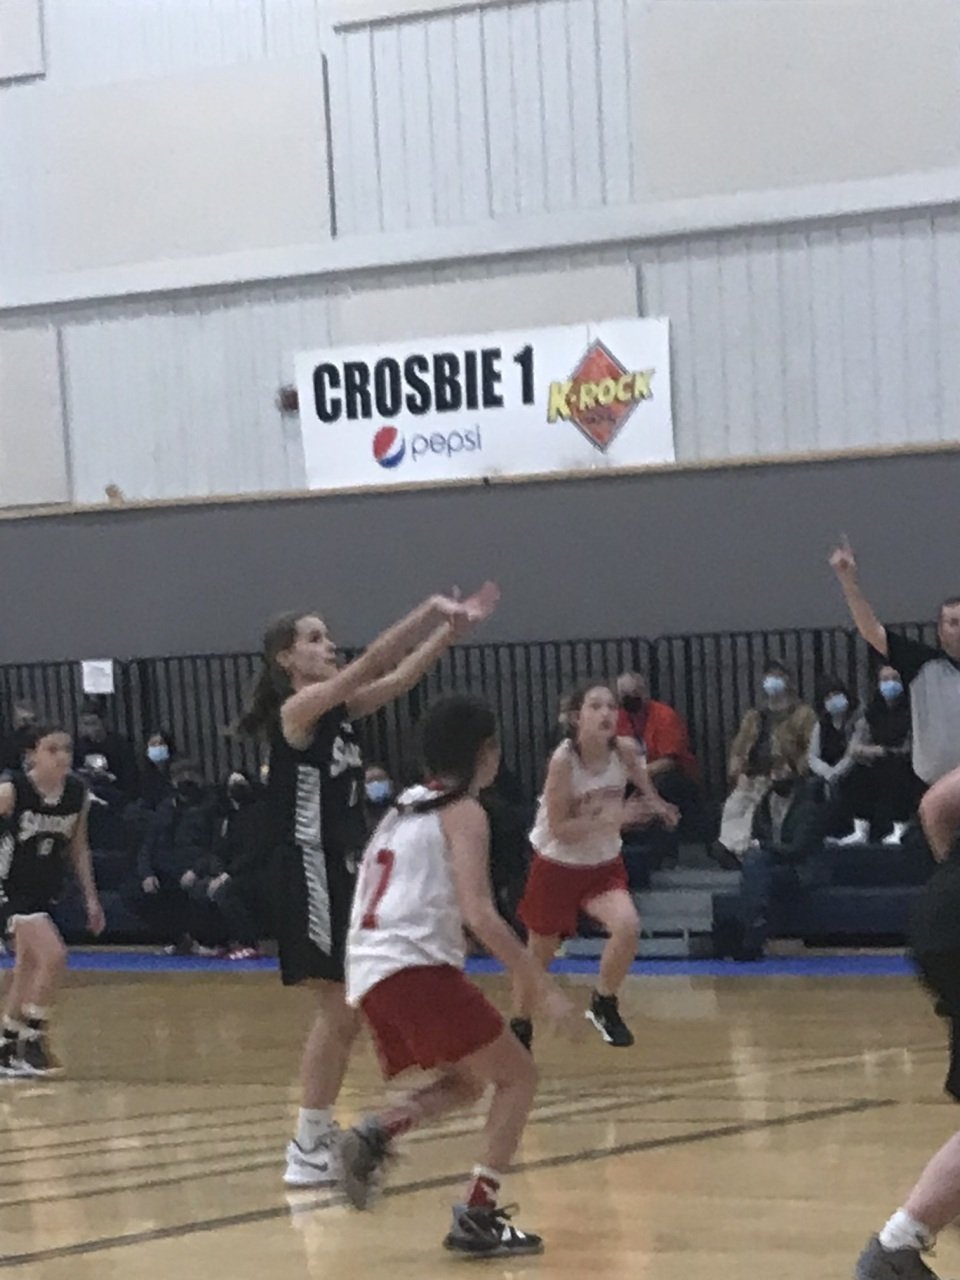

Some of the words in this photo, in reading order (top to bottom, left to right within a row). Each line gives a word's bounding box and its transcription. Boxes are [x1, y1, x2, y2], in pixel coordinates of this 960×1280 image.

[313, 349, 503, 424] CROSBIE
[513, 344, 535, 405] 1
[411, 424, 482, 462] pepsi
